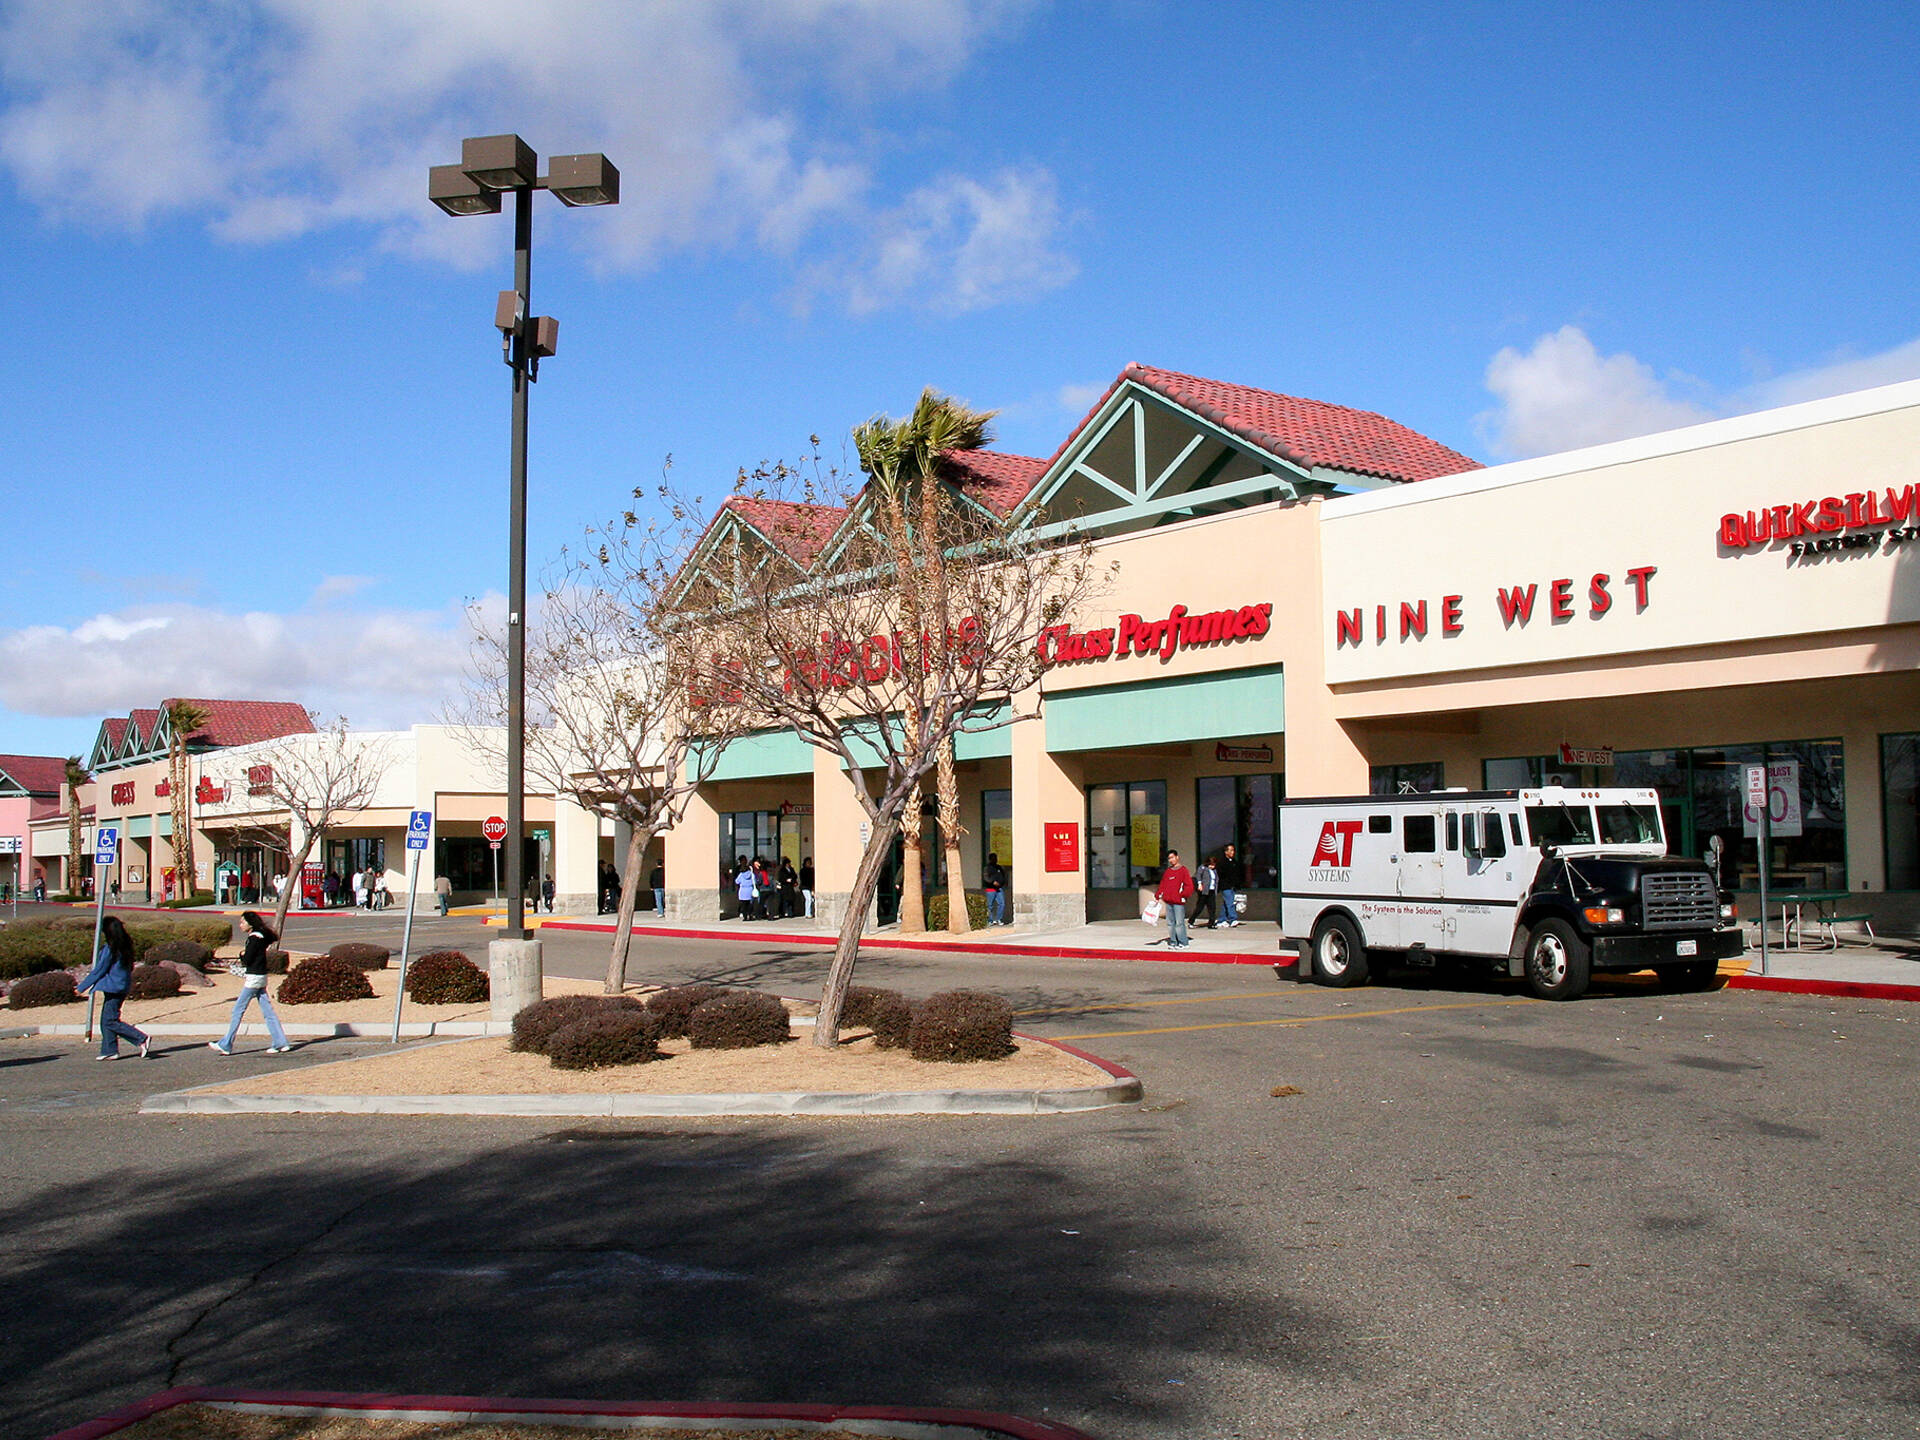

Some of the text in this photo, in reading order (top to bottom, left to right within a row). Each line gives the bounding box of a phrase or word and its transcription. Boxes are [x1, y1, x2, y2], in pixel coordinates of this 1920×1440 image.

[1720, 482, 1920, 547] QUIKSILV
[1791, 530, 1884, 556] FACTORY
[1336, 565, 1658, 646] NINE WEST
[1037, 603, 1273, 665] Class Perfumes
[1586, 751, 1611, 764] WEST
[112, 781, 135, 807] GUESS
[409, 830, 428, 839] PARKING
[485, 823, 505, 833] STOP
[1135, 822, 1157, 834] SALE
[411, 839, 424, 848] ONLY
[1311, 821, 1363, 867] AT
[1309, 869, 1351, 883] SYSTEMS
[1361, 904, 1442, 915] The System is the Solution
